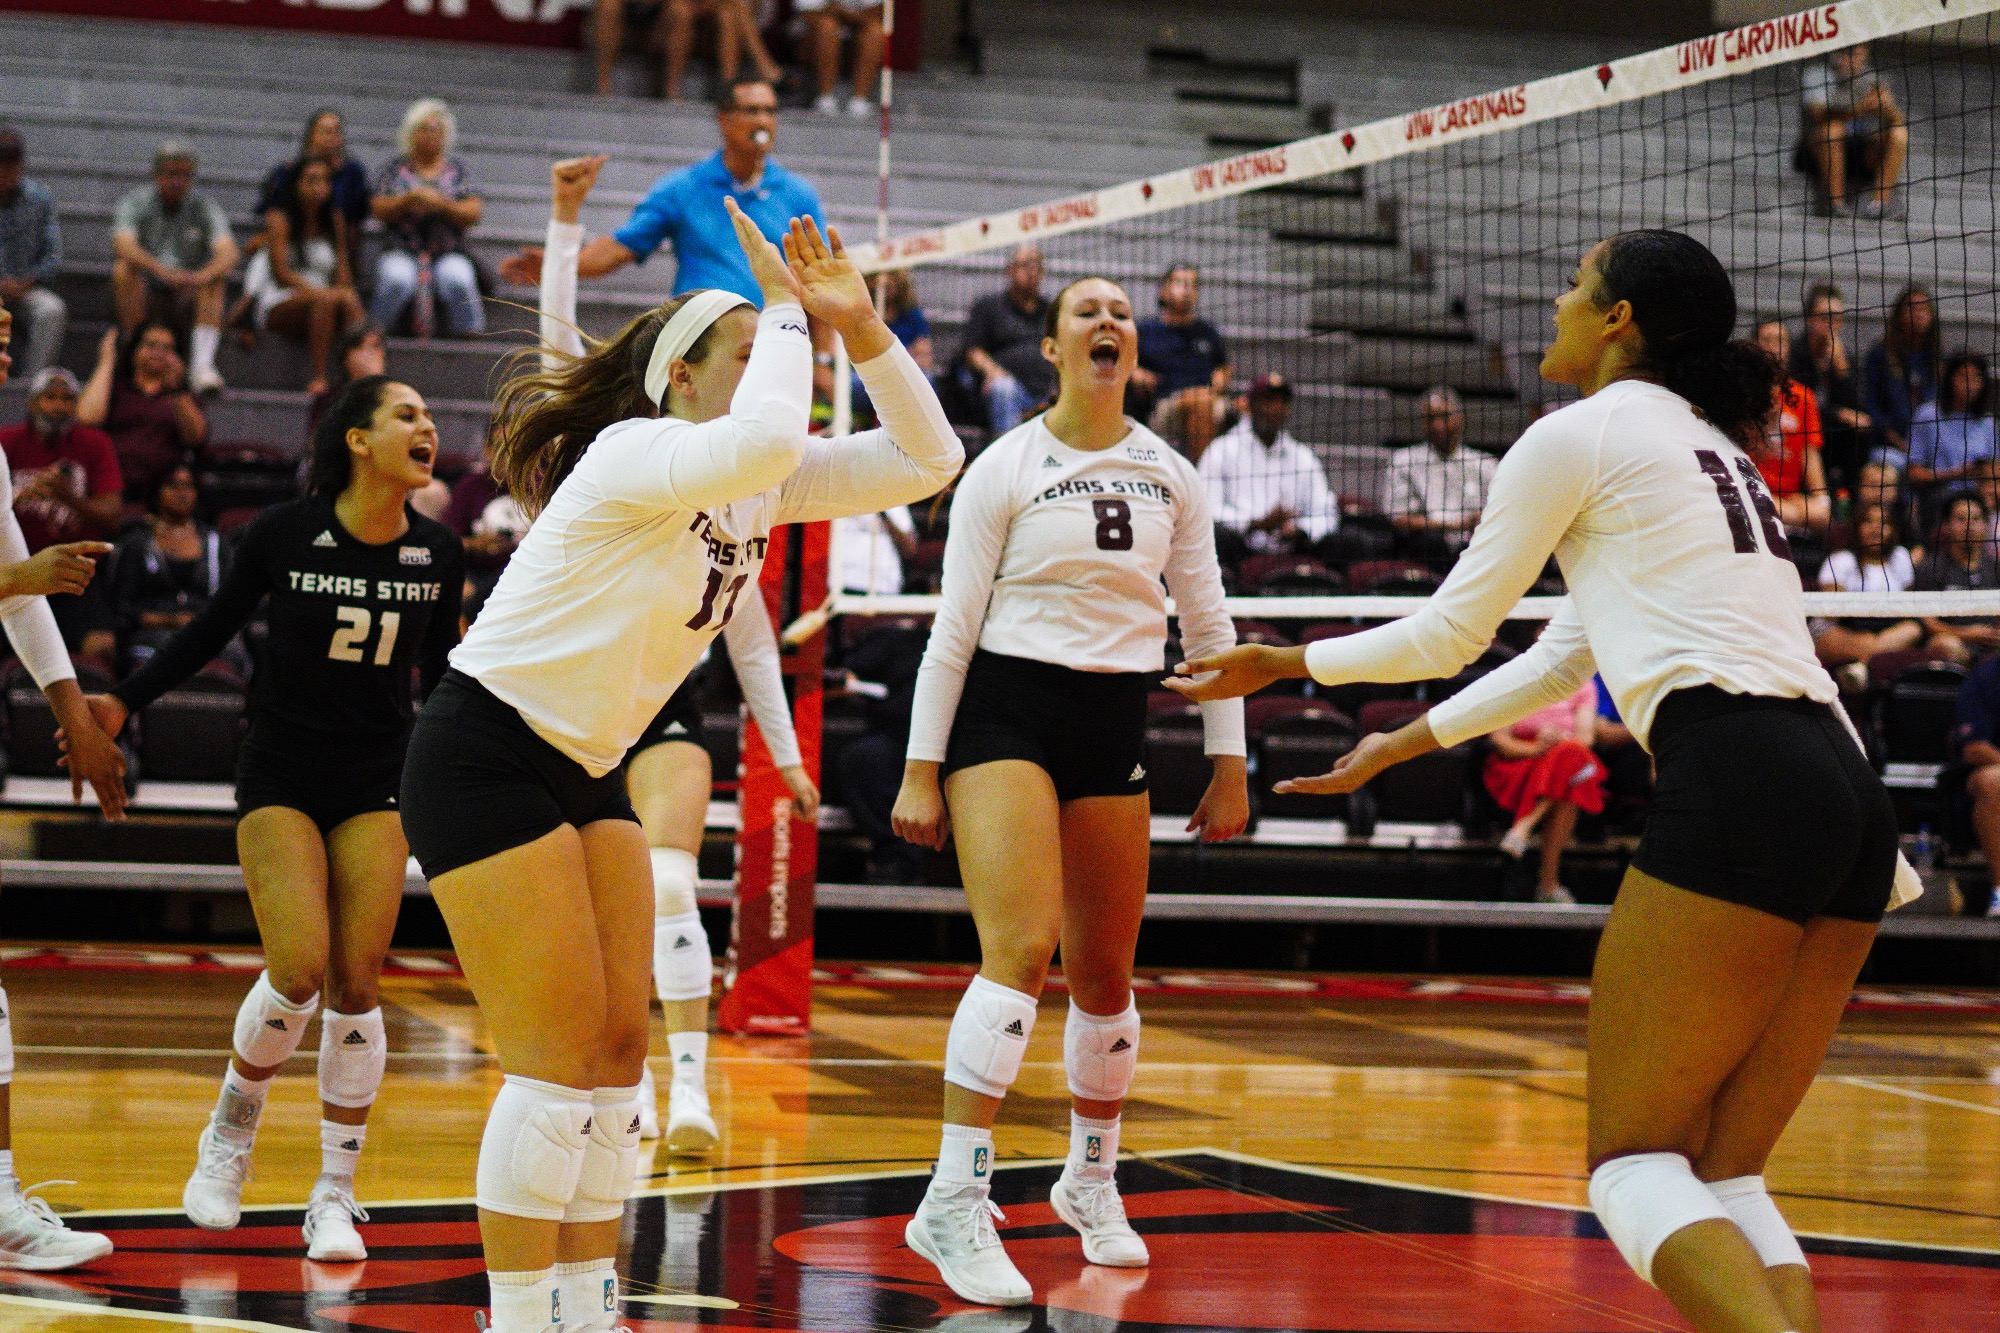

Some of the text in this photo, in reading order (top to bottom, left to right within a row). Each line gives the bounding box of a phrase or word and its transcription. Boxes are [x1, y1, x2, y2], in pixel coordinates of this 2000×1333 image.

[1723, 5, 1840, 62] CARDINALS
[1439, 84, 1527, 133] CARDINALS
[1110, 480, 1171, 506] STATE
[688, 510, 738, 567] TEAS
[1092, 499, 1134, 551] 8
[288, 570, 442, 602] TEXAS STATE
[328, 605, 401, 667] 21
